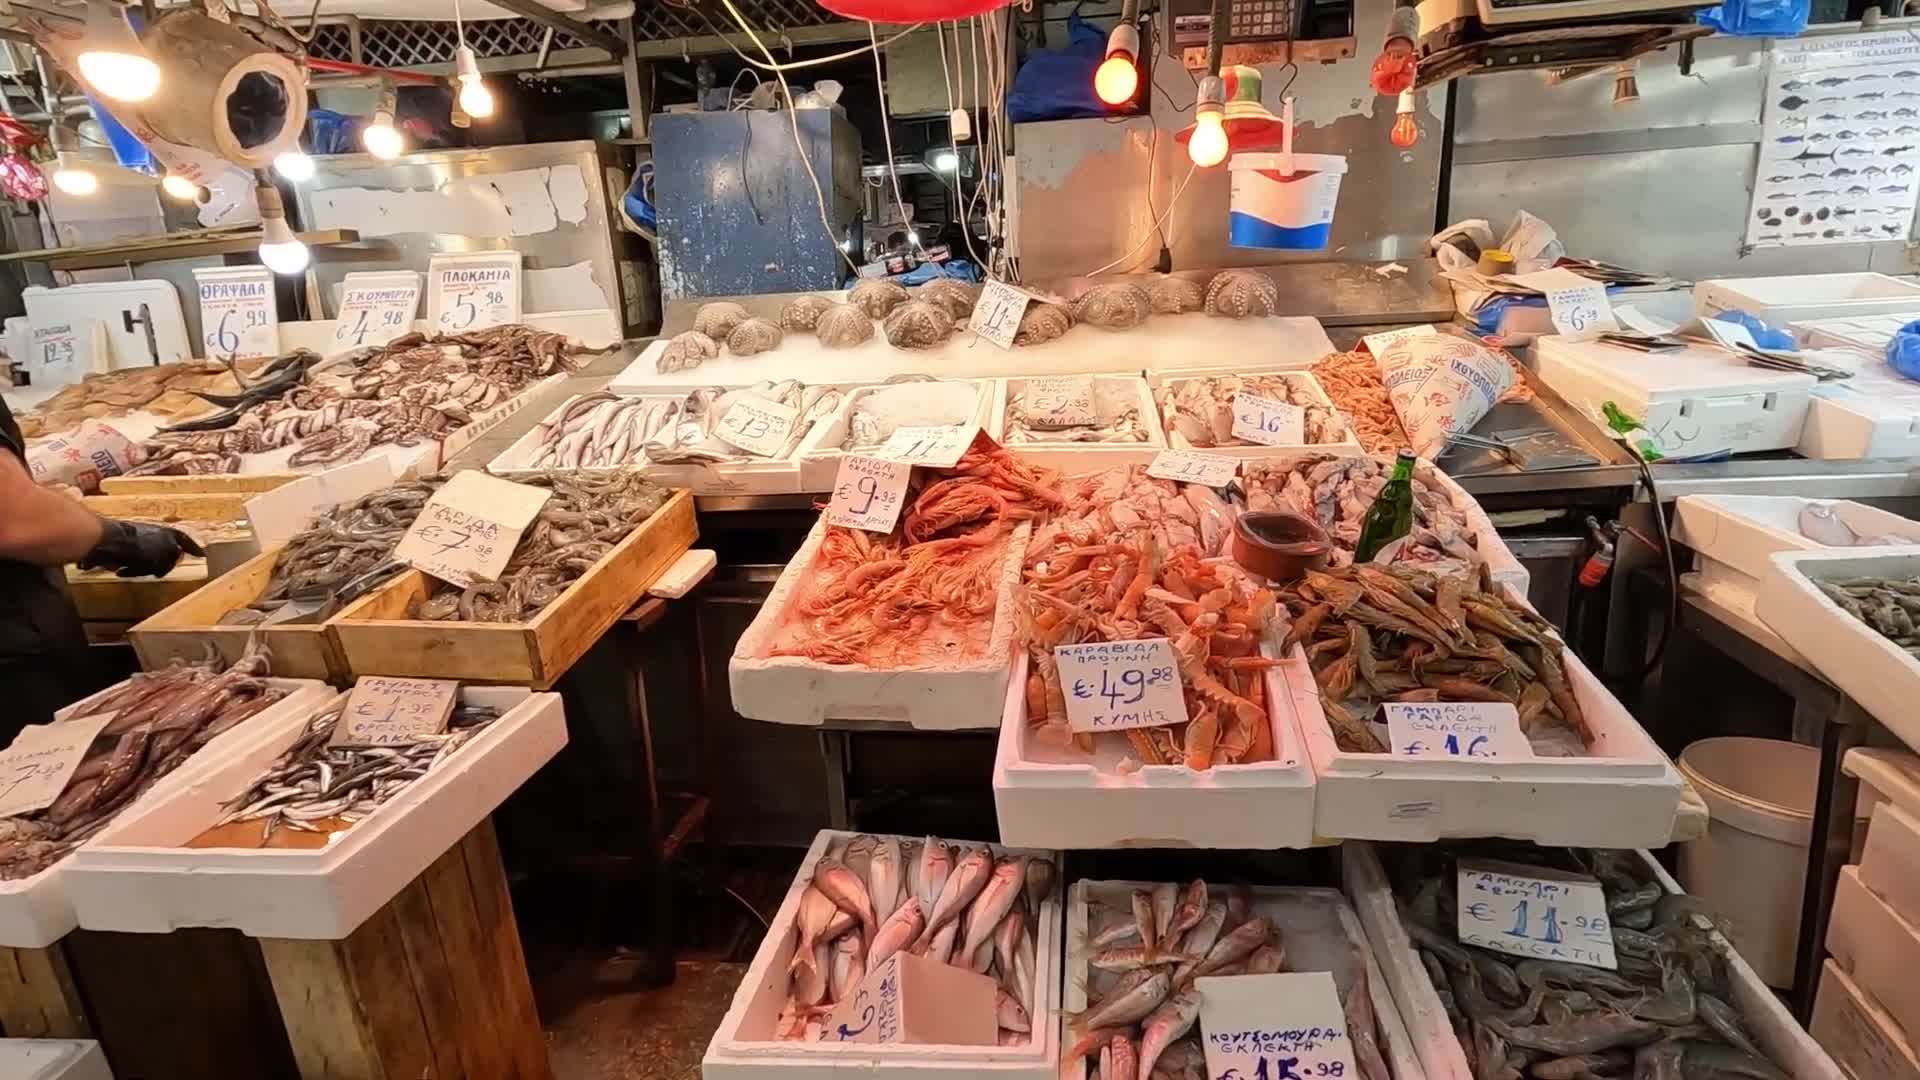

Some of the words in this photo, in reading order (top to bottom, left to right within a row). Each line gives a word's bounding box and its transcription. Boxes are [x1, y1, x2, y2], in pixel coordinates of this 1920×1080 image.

[442, 269, 511, 283] ΠΛΟΚΑΜΙΑ
[201, 283, 265, 299] ΘΡΑΨΑΛΑ
[430, 503, 498, 534] ΓΑΡΙΔΑ
[1060, 643, 1159, 656] ΚΑΡΑΒΙΔΑ
[1093, 710, 1169, 725] ΚΥΜΗΣ
[1391, 705, 1476, 715] ΓΑΜΠΑΡΙ
[1466, 872, 1570, 896] ΓΑΜΠΑΡΙ
